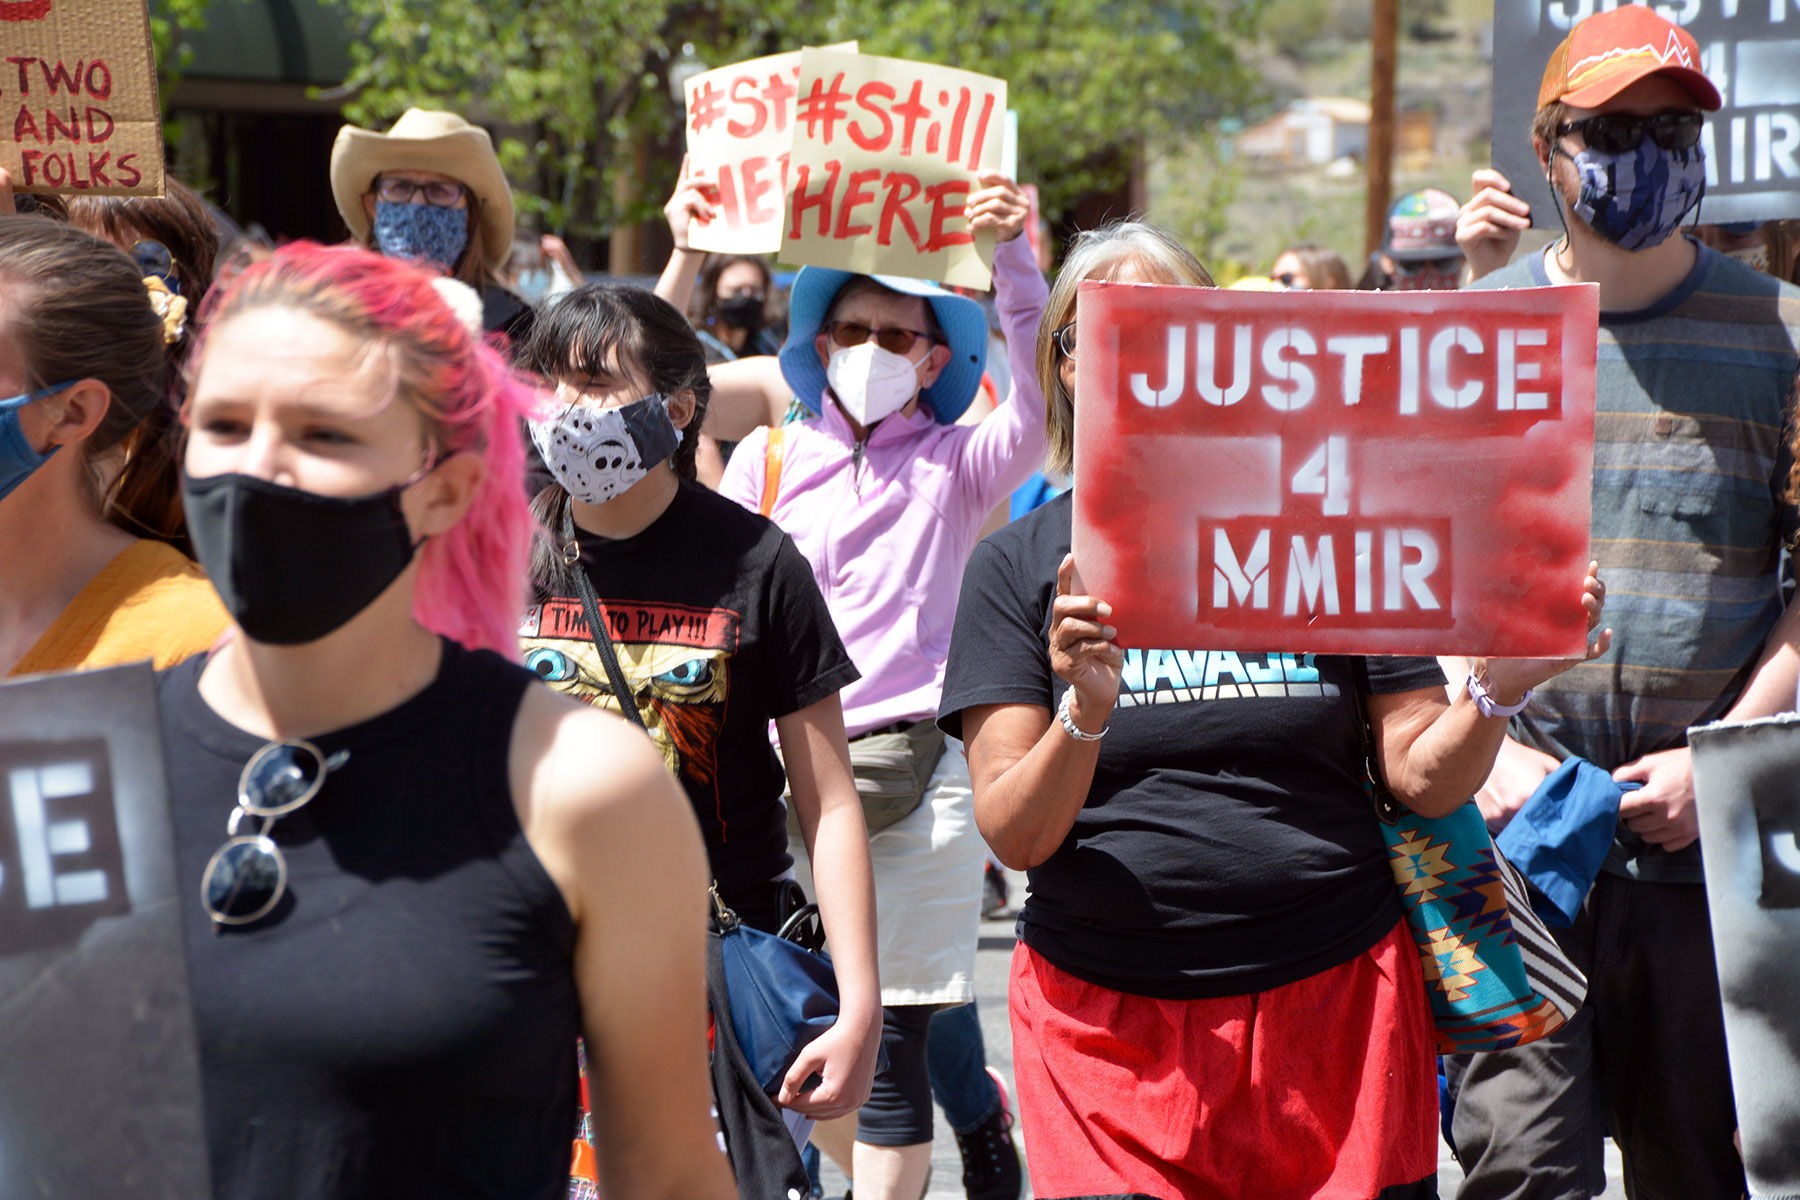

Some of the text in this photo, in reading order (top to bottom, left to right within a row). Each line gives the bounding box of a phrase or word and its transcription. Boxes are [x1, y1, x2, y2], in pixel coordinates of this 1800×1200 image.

[6, 57, 112, 101] TWO
[690, 66, 800, 137] #St
[14, 104, 115, 145] AND
[796, 72, 995, 171] #Still
[22, 150, 142, 189] FOLKS
[695, 152, 791, 230] HE
[788, 160, 976, 253] HERE
[1129, 324, 1549, 415] JUSTICE
[1291, 436, 1350, 517] 4
[1213, 527, 1441, 616] MMIR
[551, 606, 590, 634] TIM
[607, 610, 630, 635] TO
[636, 607, 709, 642] PLAY!!!
